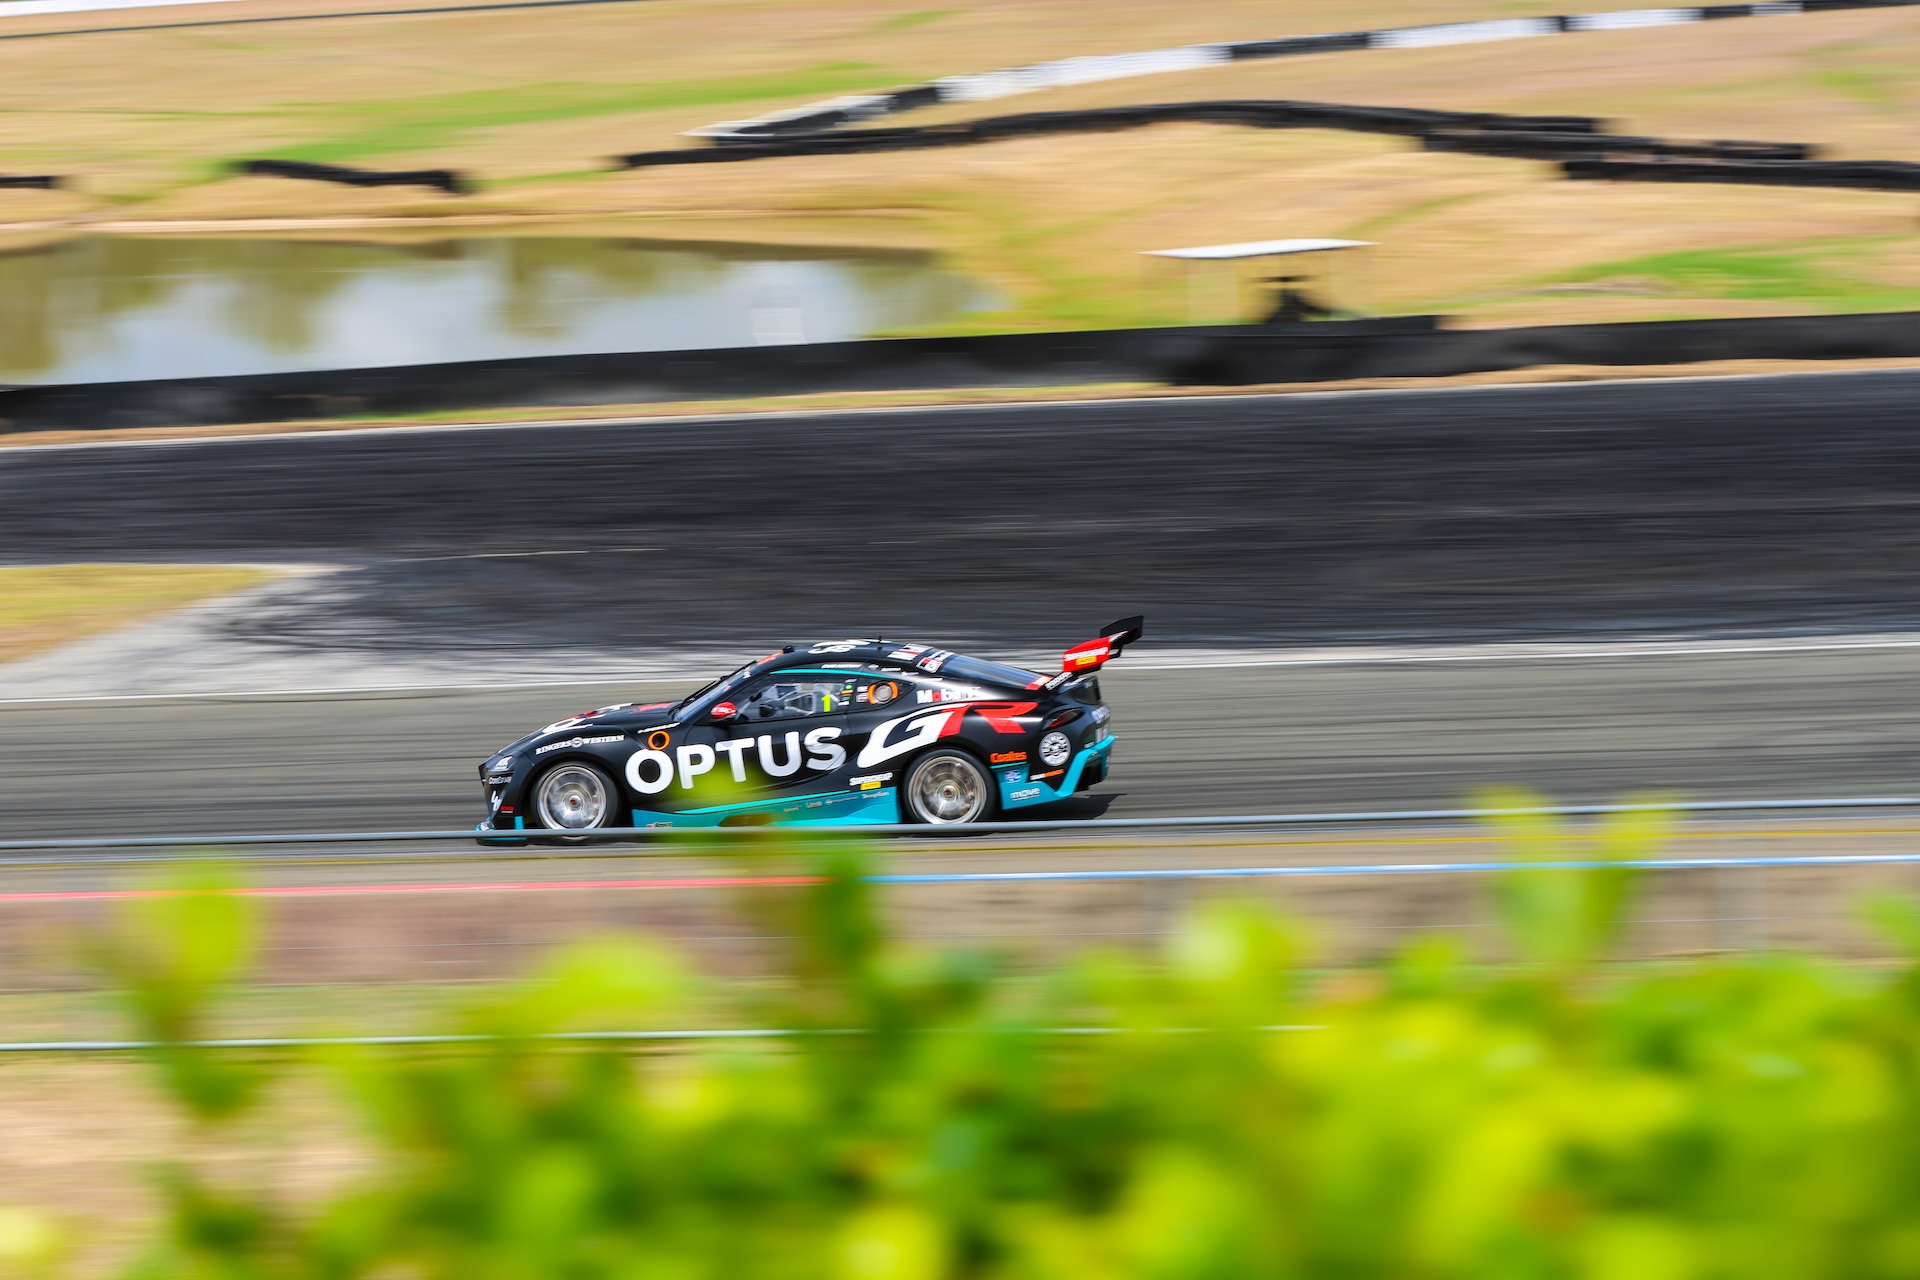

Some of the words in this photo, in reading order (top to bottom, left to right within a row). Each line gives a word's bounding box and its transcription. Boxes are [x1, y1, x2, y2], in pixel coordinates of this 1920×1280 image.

[821, 694, 831, 712] 1
[535, 740, 572, 756] RINGERS
[583, 734, 625, 745] WESTERN
[625, 727, 847, 794] OPTUS
[990, 751, 1028, 763] Coates
[849, 772, 893, 786] SUPERCHEAP
[1009, 788, 1040, 799] move
